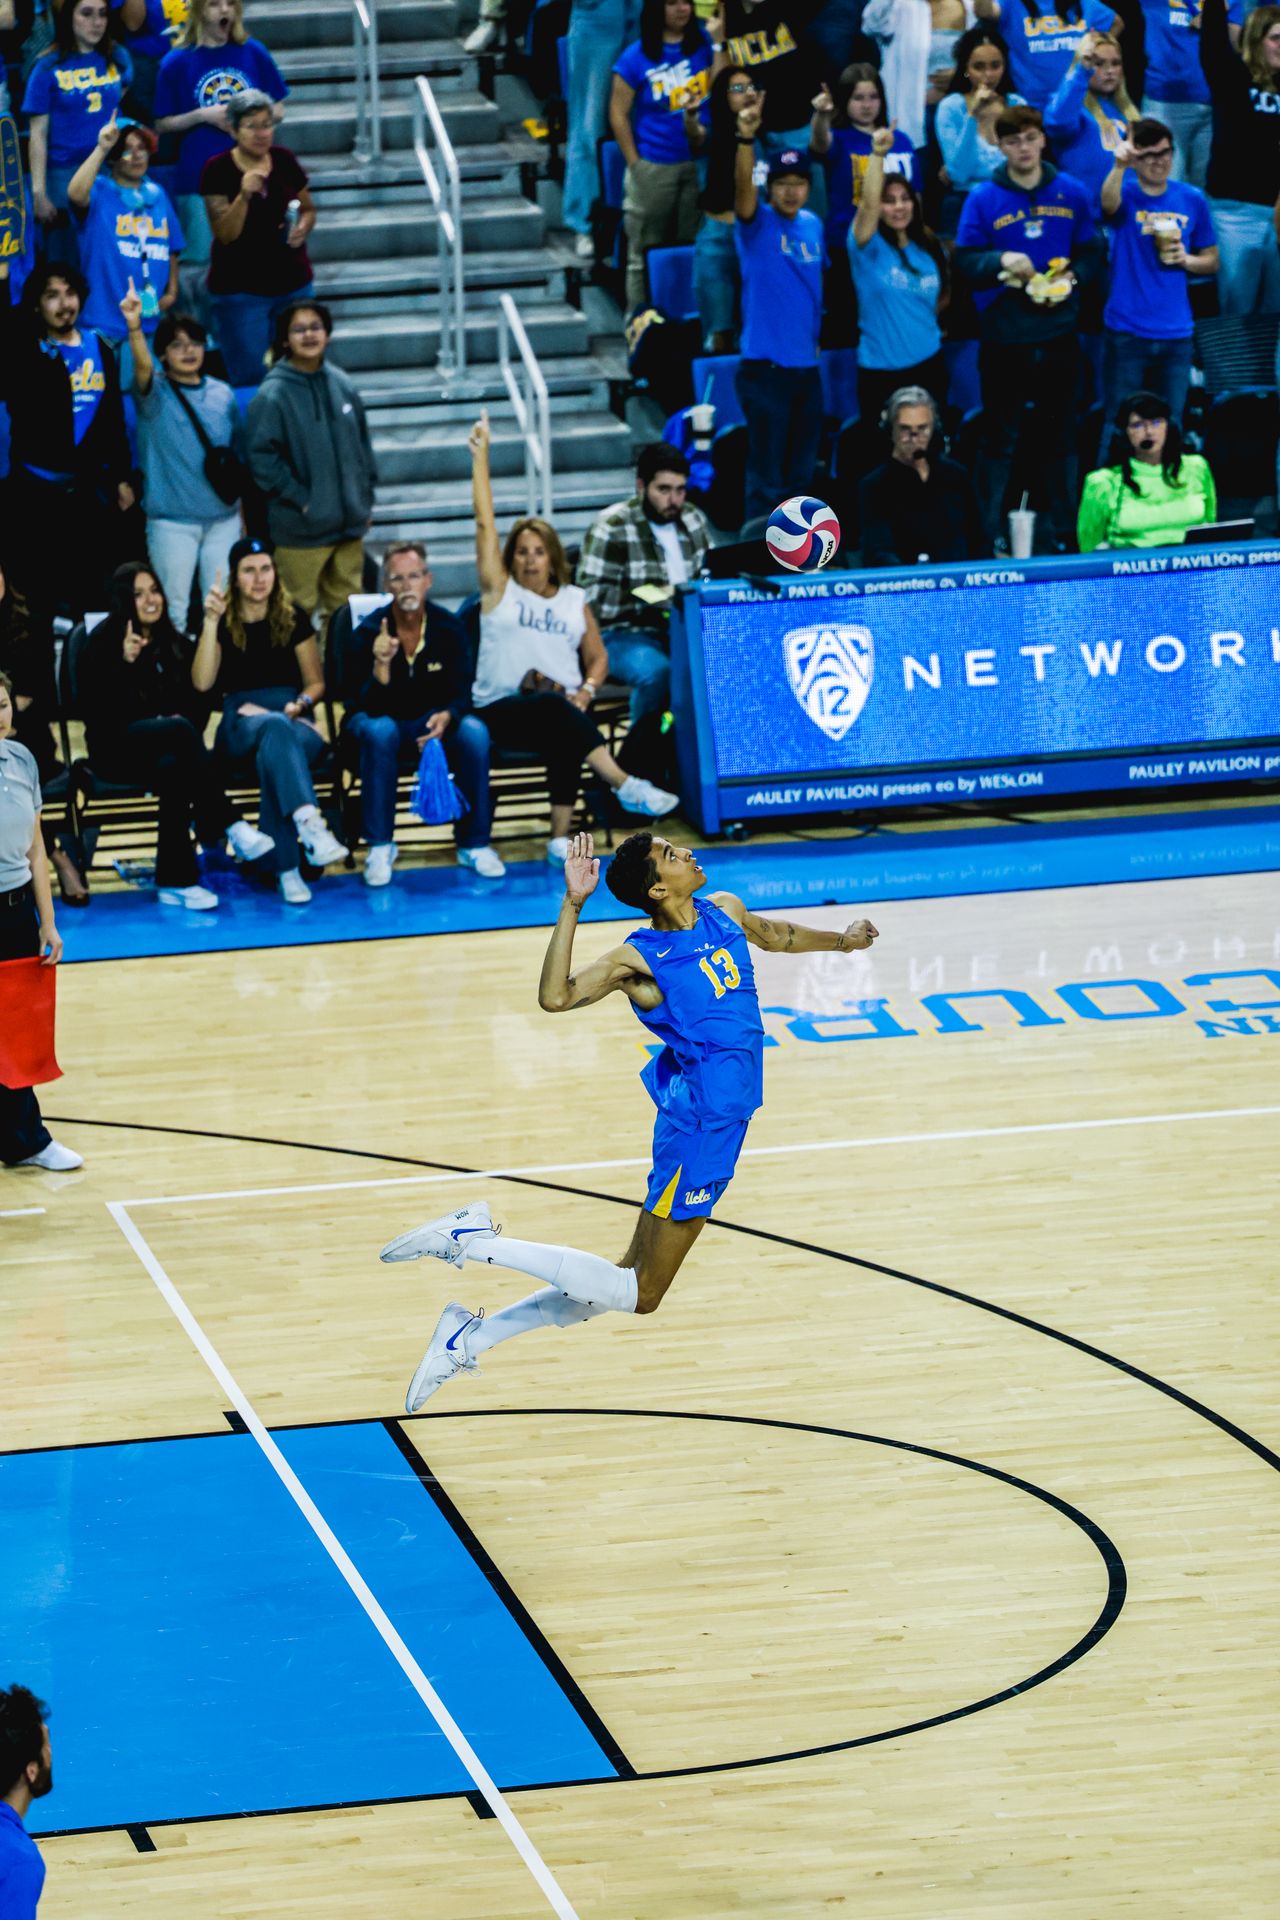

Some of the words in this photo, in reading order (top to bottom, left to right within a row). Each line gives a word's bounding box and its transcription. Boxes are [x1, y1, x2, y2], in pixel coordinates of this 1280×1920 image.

[728, 22, 797, 66] UCLA
[69, 358, 106, 392] cla
[1112, 558, 1169, 575] PAULEY
[1172, 551, 1245, 571] PAVILION
[787, 581, 861, 599] PAVILON
[516, 600, 569, 636] Ucla
[785, 628, 870, 695] PAC
[818, 684, 851, 717] 12
[1129, 761, 1185, 780] PAULEY
[1188, 756, 1262, 776] PAVILION
[806, 782, 879, 803] PAVILION
[957, 776, 976, 794] by
[699, 947, 741, 999] 13
[648, 968, 1280, 1053] COUR
[685, 1188, 712, 1206] Ucla
